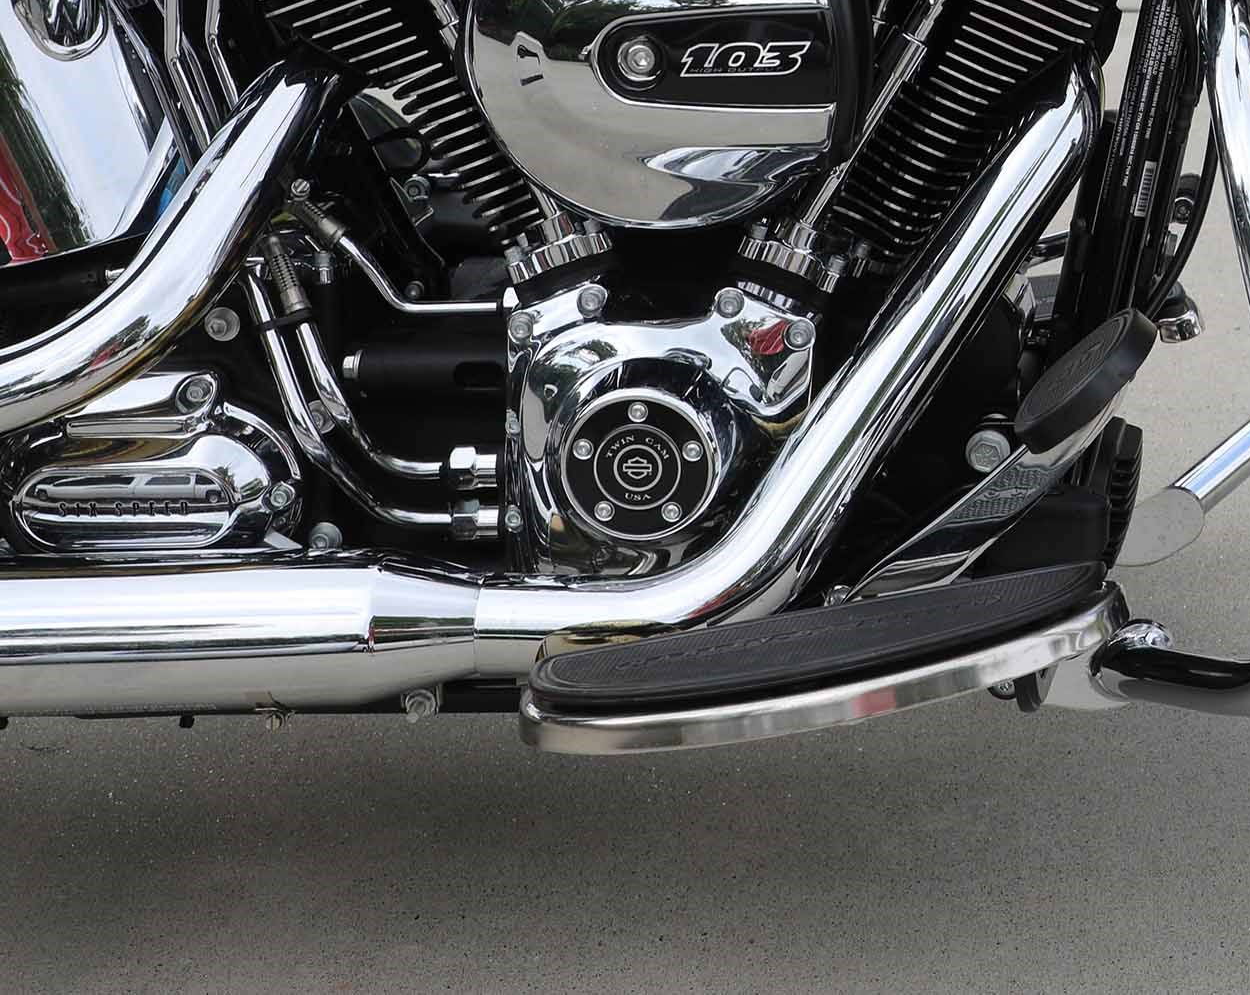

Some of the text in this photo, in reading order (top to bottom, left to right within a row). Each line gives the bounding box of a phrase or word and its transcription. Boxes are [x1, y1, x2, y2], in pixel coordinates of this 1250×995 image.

[680, 41, 811, 77] 103
[606, 435, 670, 460] TWIN CAM
[624, 492, 651, 501] USA
[58, 500, 188, 517] SIX SPEED
